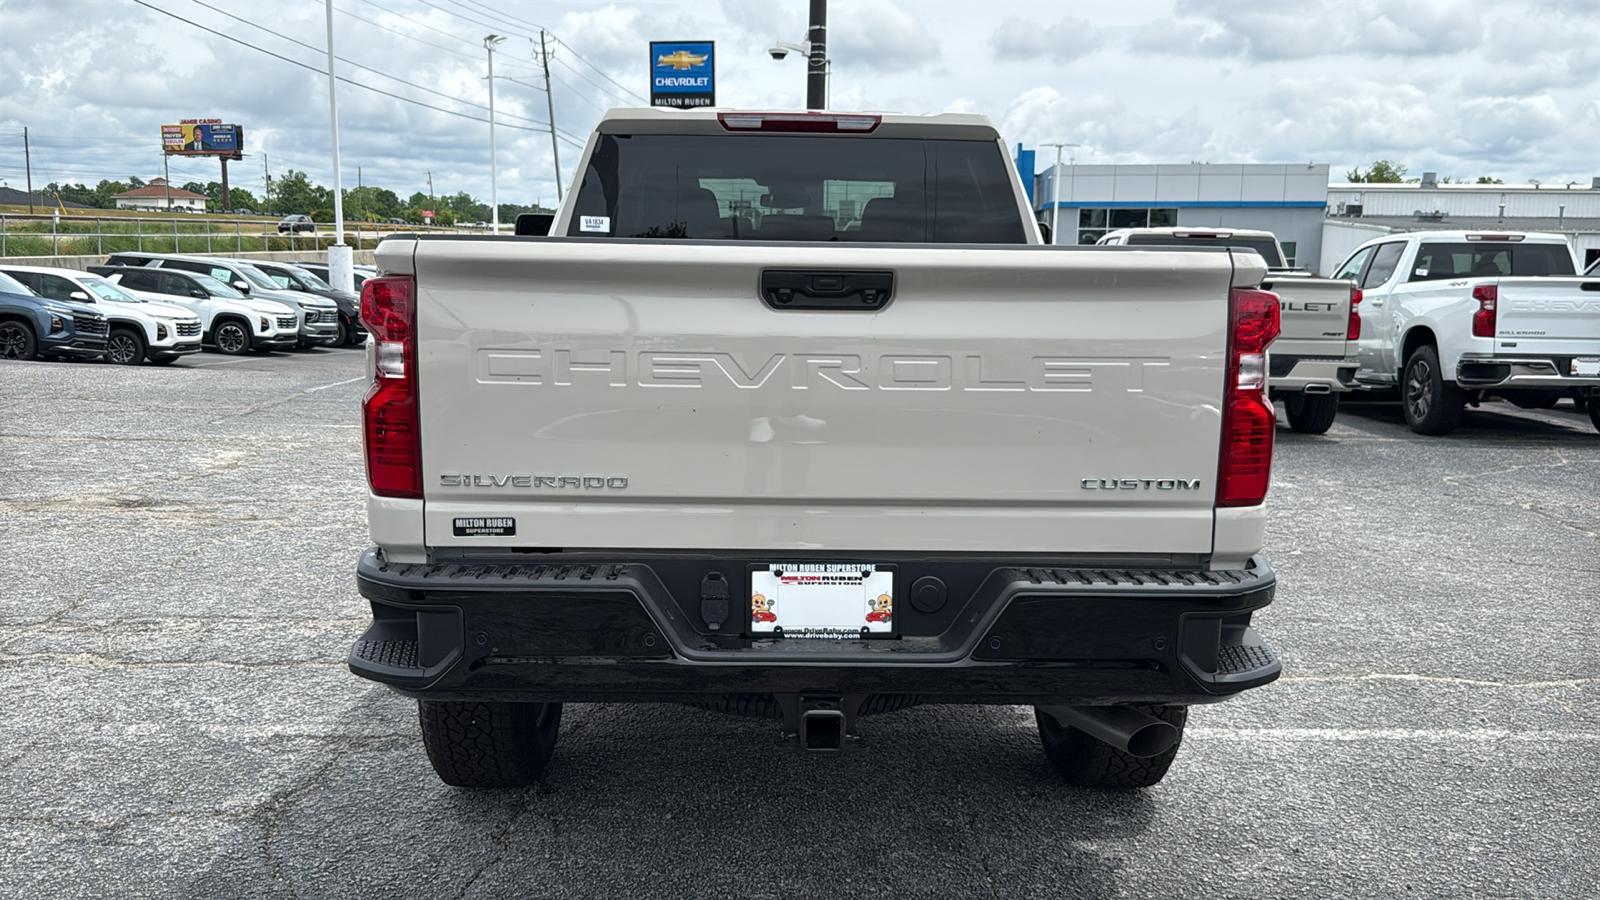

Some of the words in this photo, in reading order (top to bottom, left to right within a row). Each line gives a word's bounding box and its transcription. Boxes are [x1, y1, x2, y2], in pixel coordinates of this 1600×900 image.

[655, 77, 709, 86] CHEVROLET
[655, 98, 682, 106] MILTON
[684, 98, 710, 106] RUBEN
[475, 347, 1171, 393] CHEVROLET
[440, 474, 628, 489] SILVERADO
[1081, 478, 1200, 490] CUSTOM
[455, 519, 485, 528] MILTON
[486, 519, 513, 528] RUBEN
[769, 563, 798, 572] MILTON
[799, 563, 825, 572] RUBEN
[826, 563, 876, 572] SUPERSTORE
